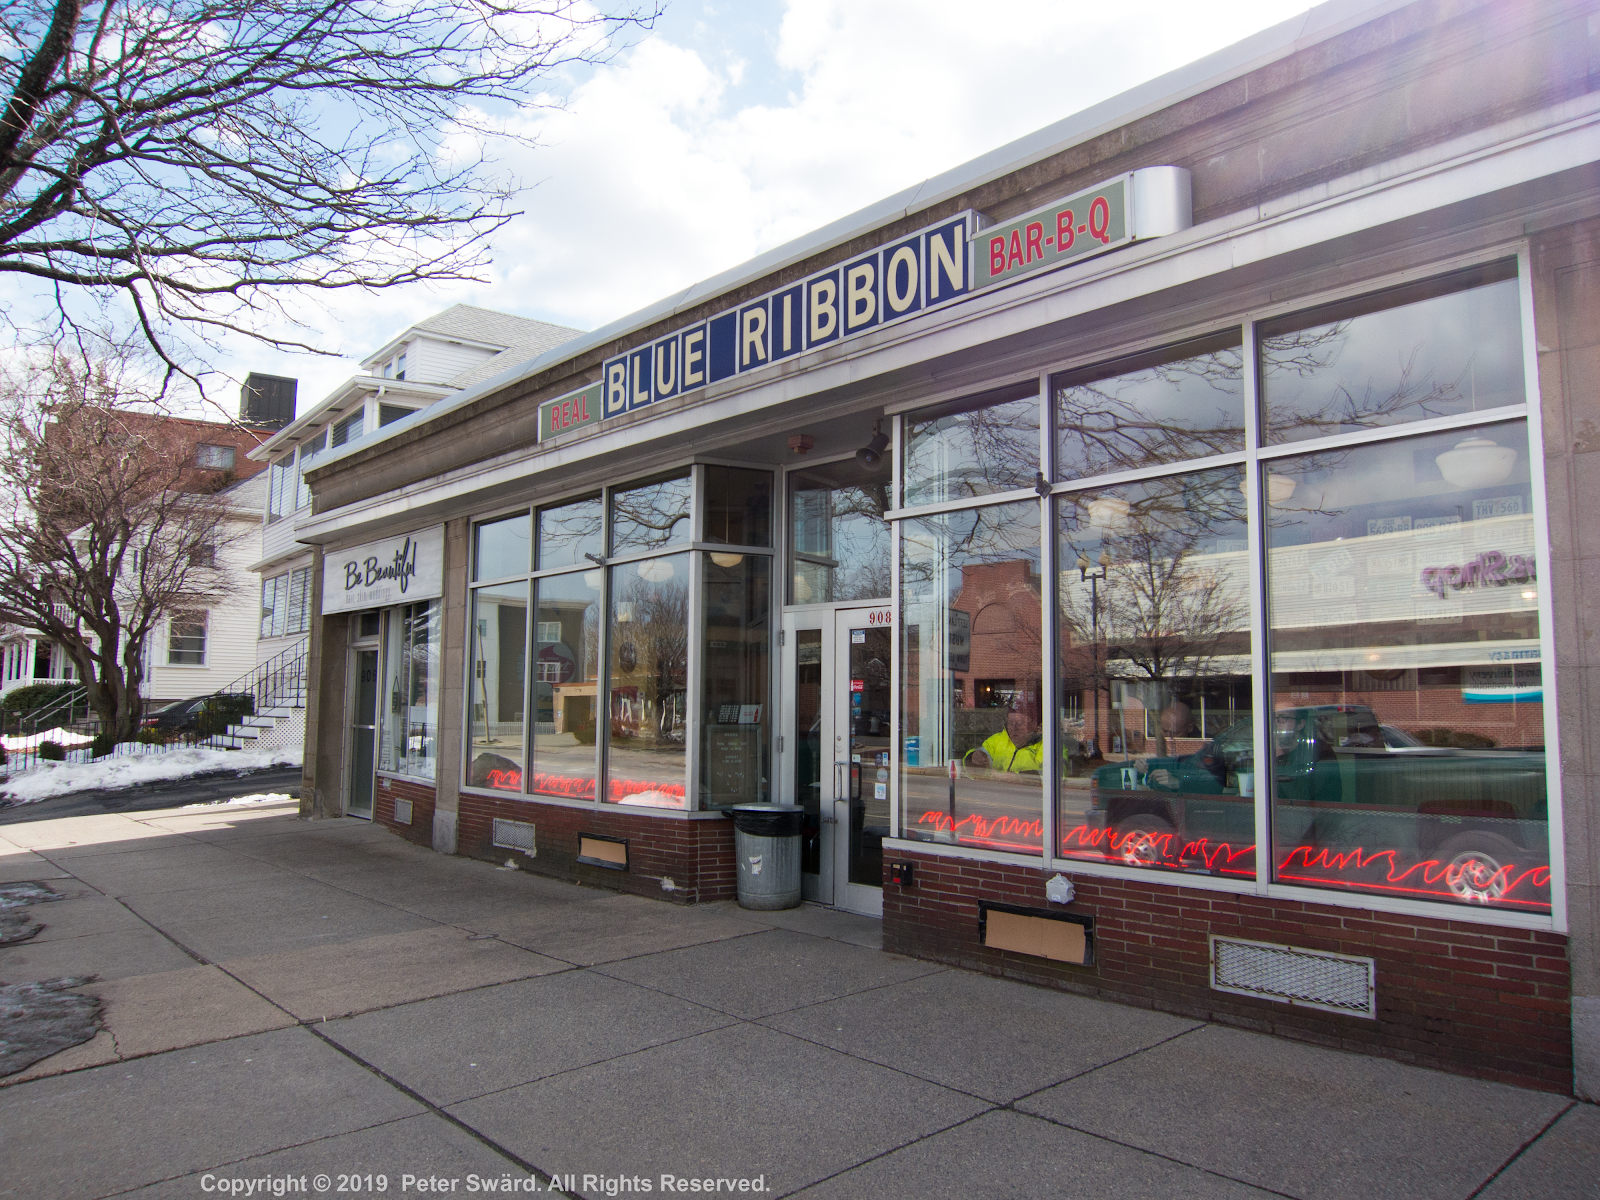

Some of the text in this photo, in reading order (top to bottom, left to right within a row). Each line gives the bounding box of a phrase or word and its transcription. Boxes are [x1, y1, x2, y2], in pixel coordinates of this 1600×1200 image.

[551, 195, 1111, 433] REAL BLUE RIBBON BAR-B-Q
[343, 536, 417, 594] Be Beautiful
[869, 609, 892, 626] 908
